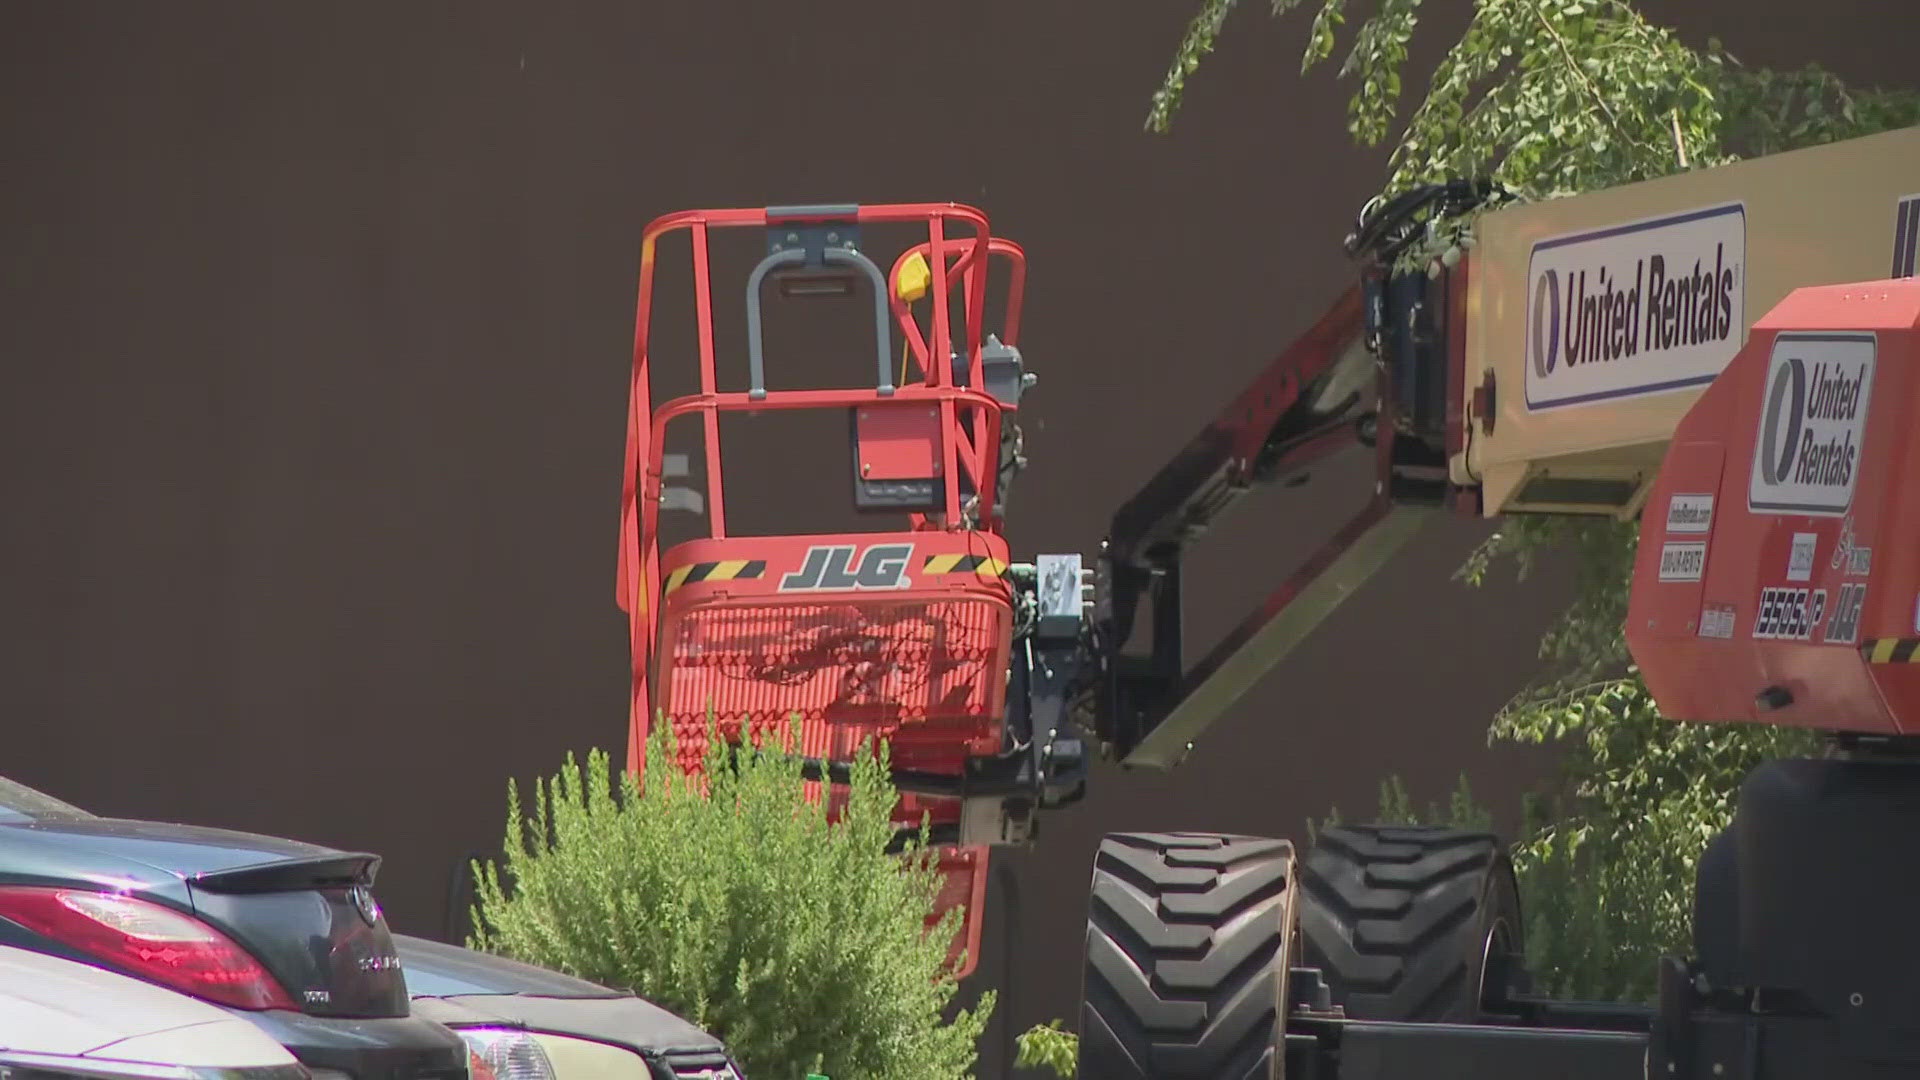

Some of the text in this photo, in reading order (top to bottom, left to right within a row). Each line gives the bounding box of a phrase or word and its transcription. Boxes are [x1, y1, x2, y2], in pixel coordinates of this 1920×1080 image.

[1564, 241, 1733, 369] United Rentals
[1806, 361, 1865, 421] United
[1793, 427, 1855, 488] Rentals
[779, 544, 912, 592] JLG
[1824, 583, 1867, 643] JLG
